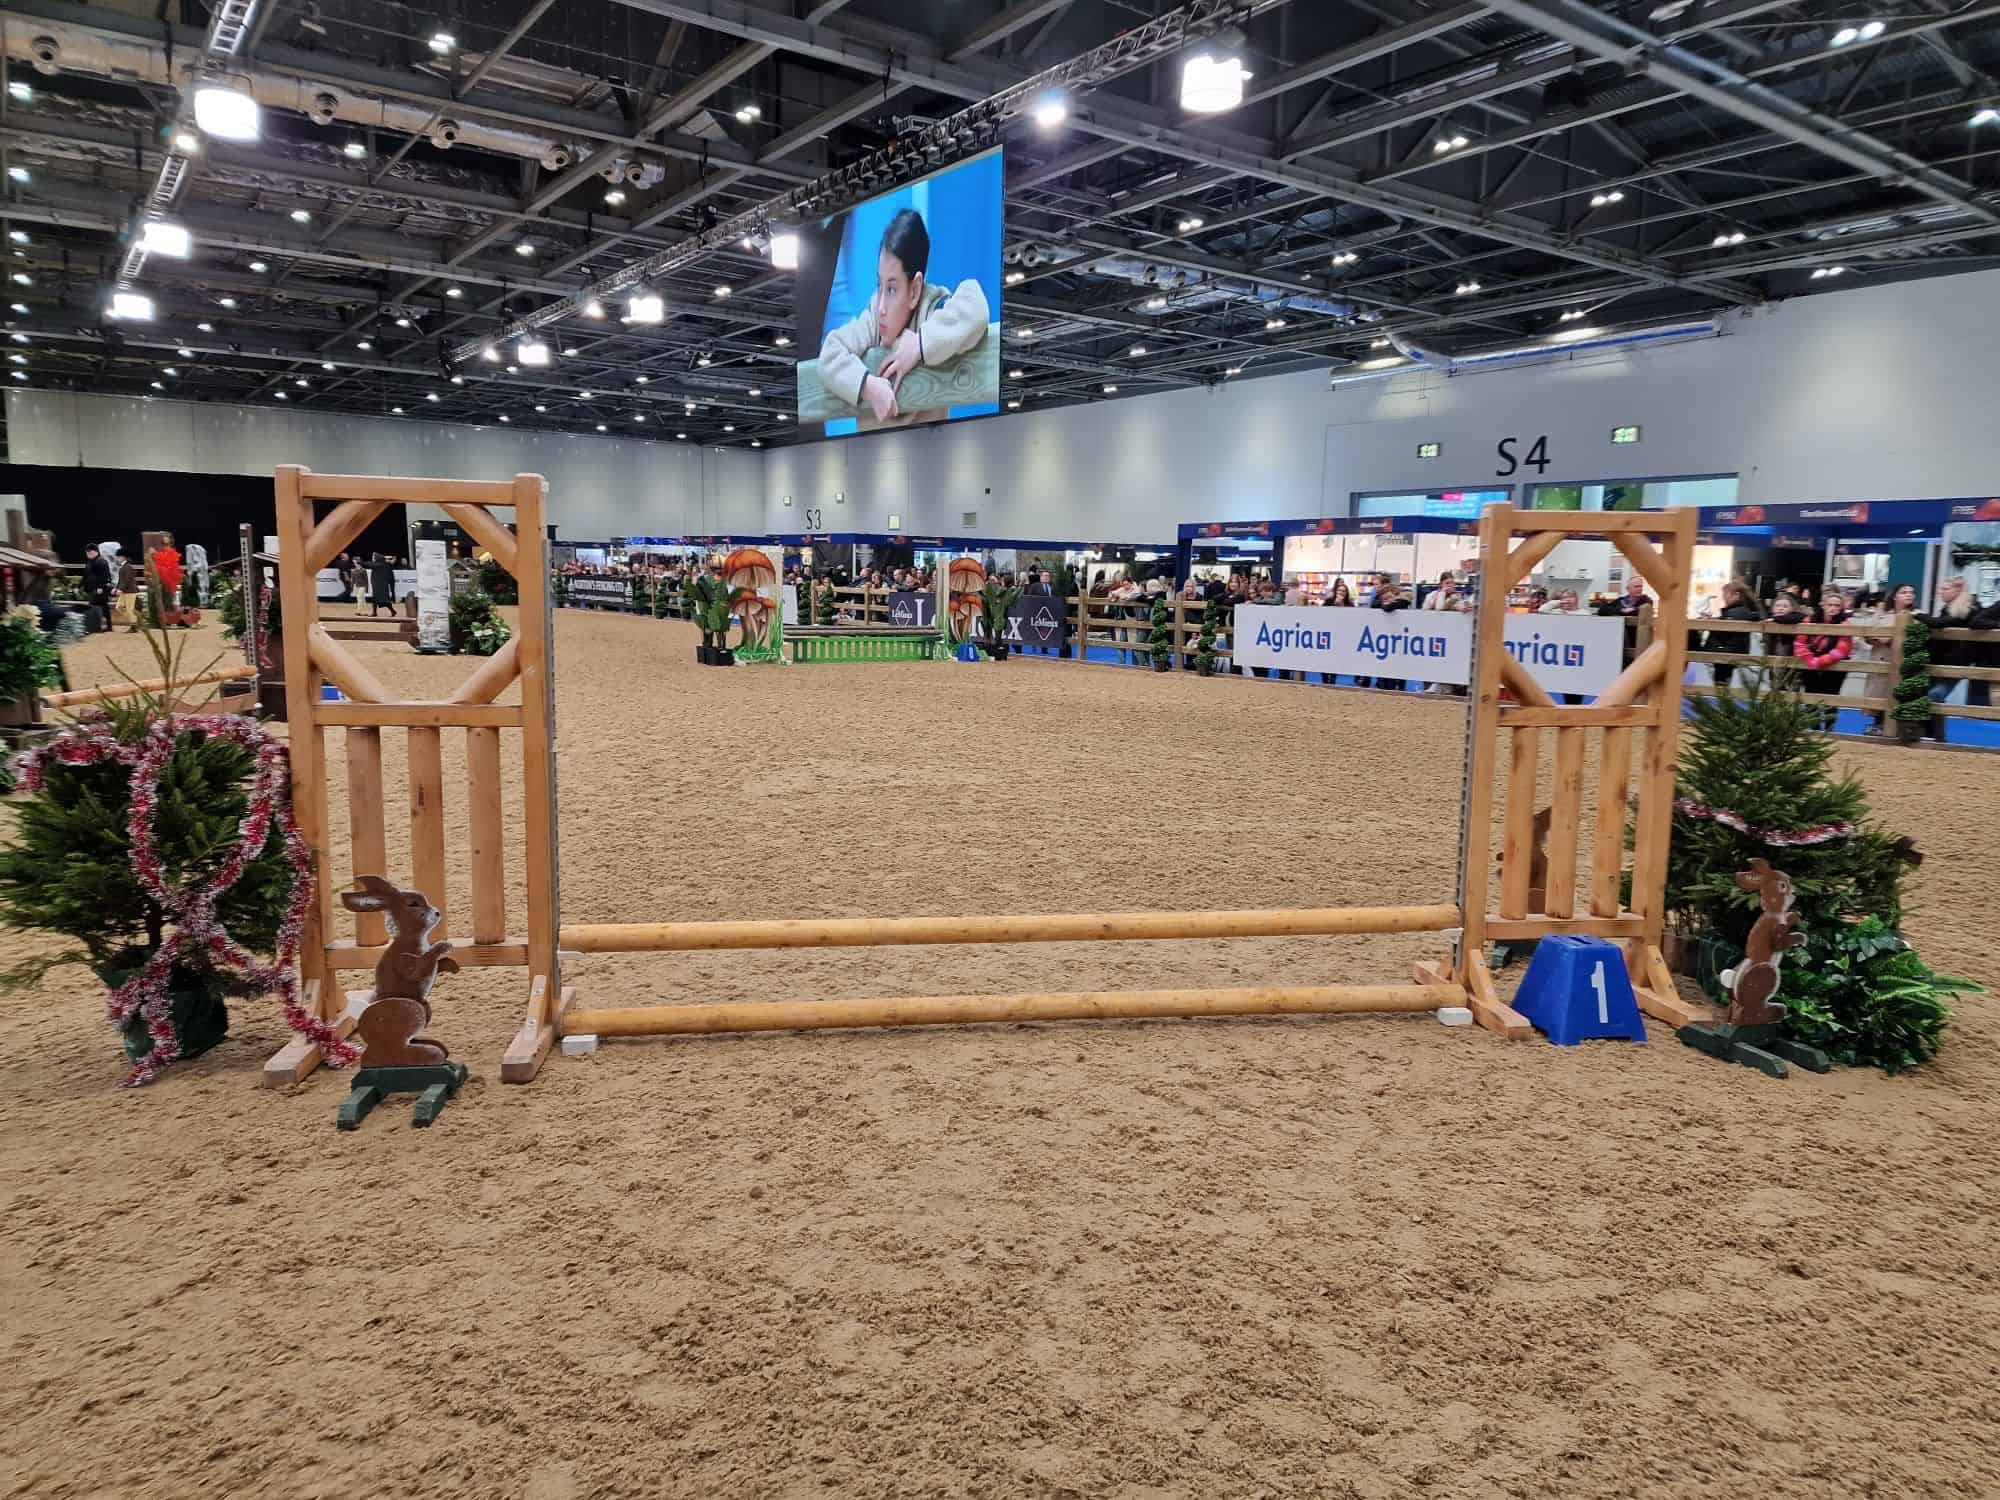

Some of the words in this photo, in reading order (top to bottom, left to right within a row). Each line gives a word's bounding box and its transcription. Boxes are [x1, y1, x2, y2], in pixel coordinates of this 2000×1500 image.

[1495, 435, 1551, 477] S4
[805, 508, 822, 530] S3
[1255, 621, 1314, 652] Agria
[1356, 625, 1426, 660] Agria
[1591, 961, 1609, 1024] 1
